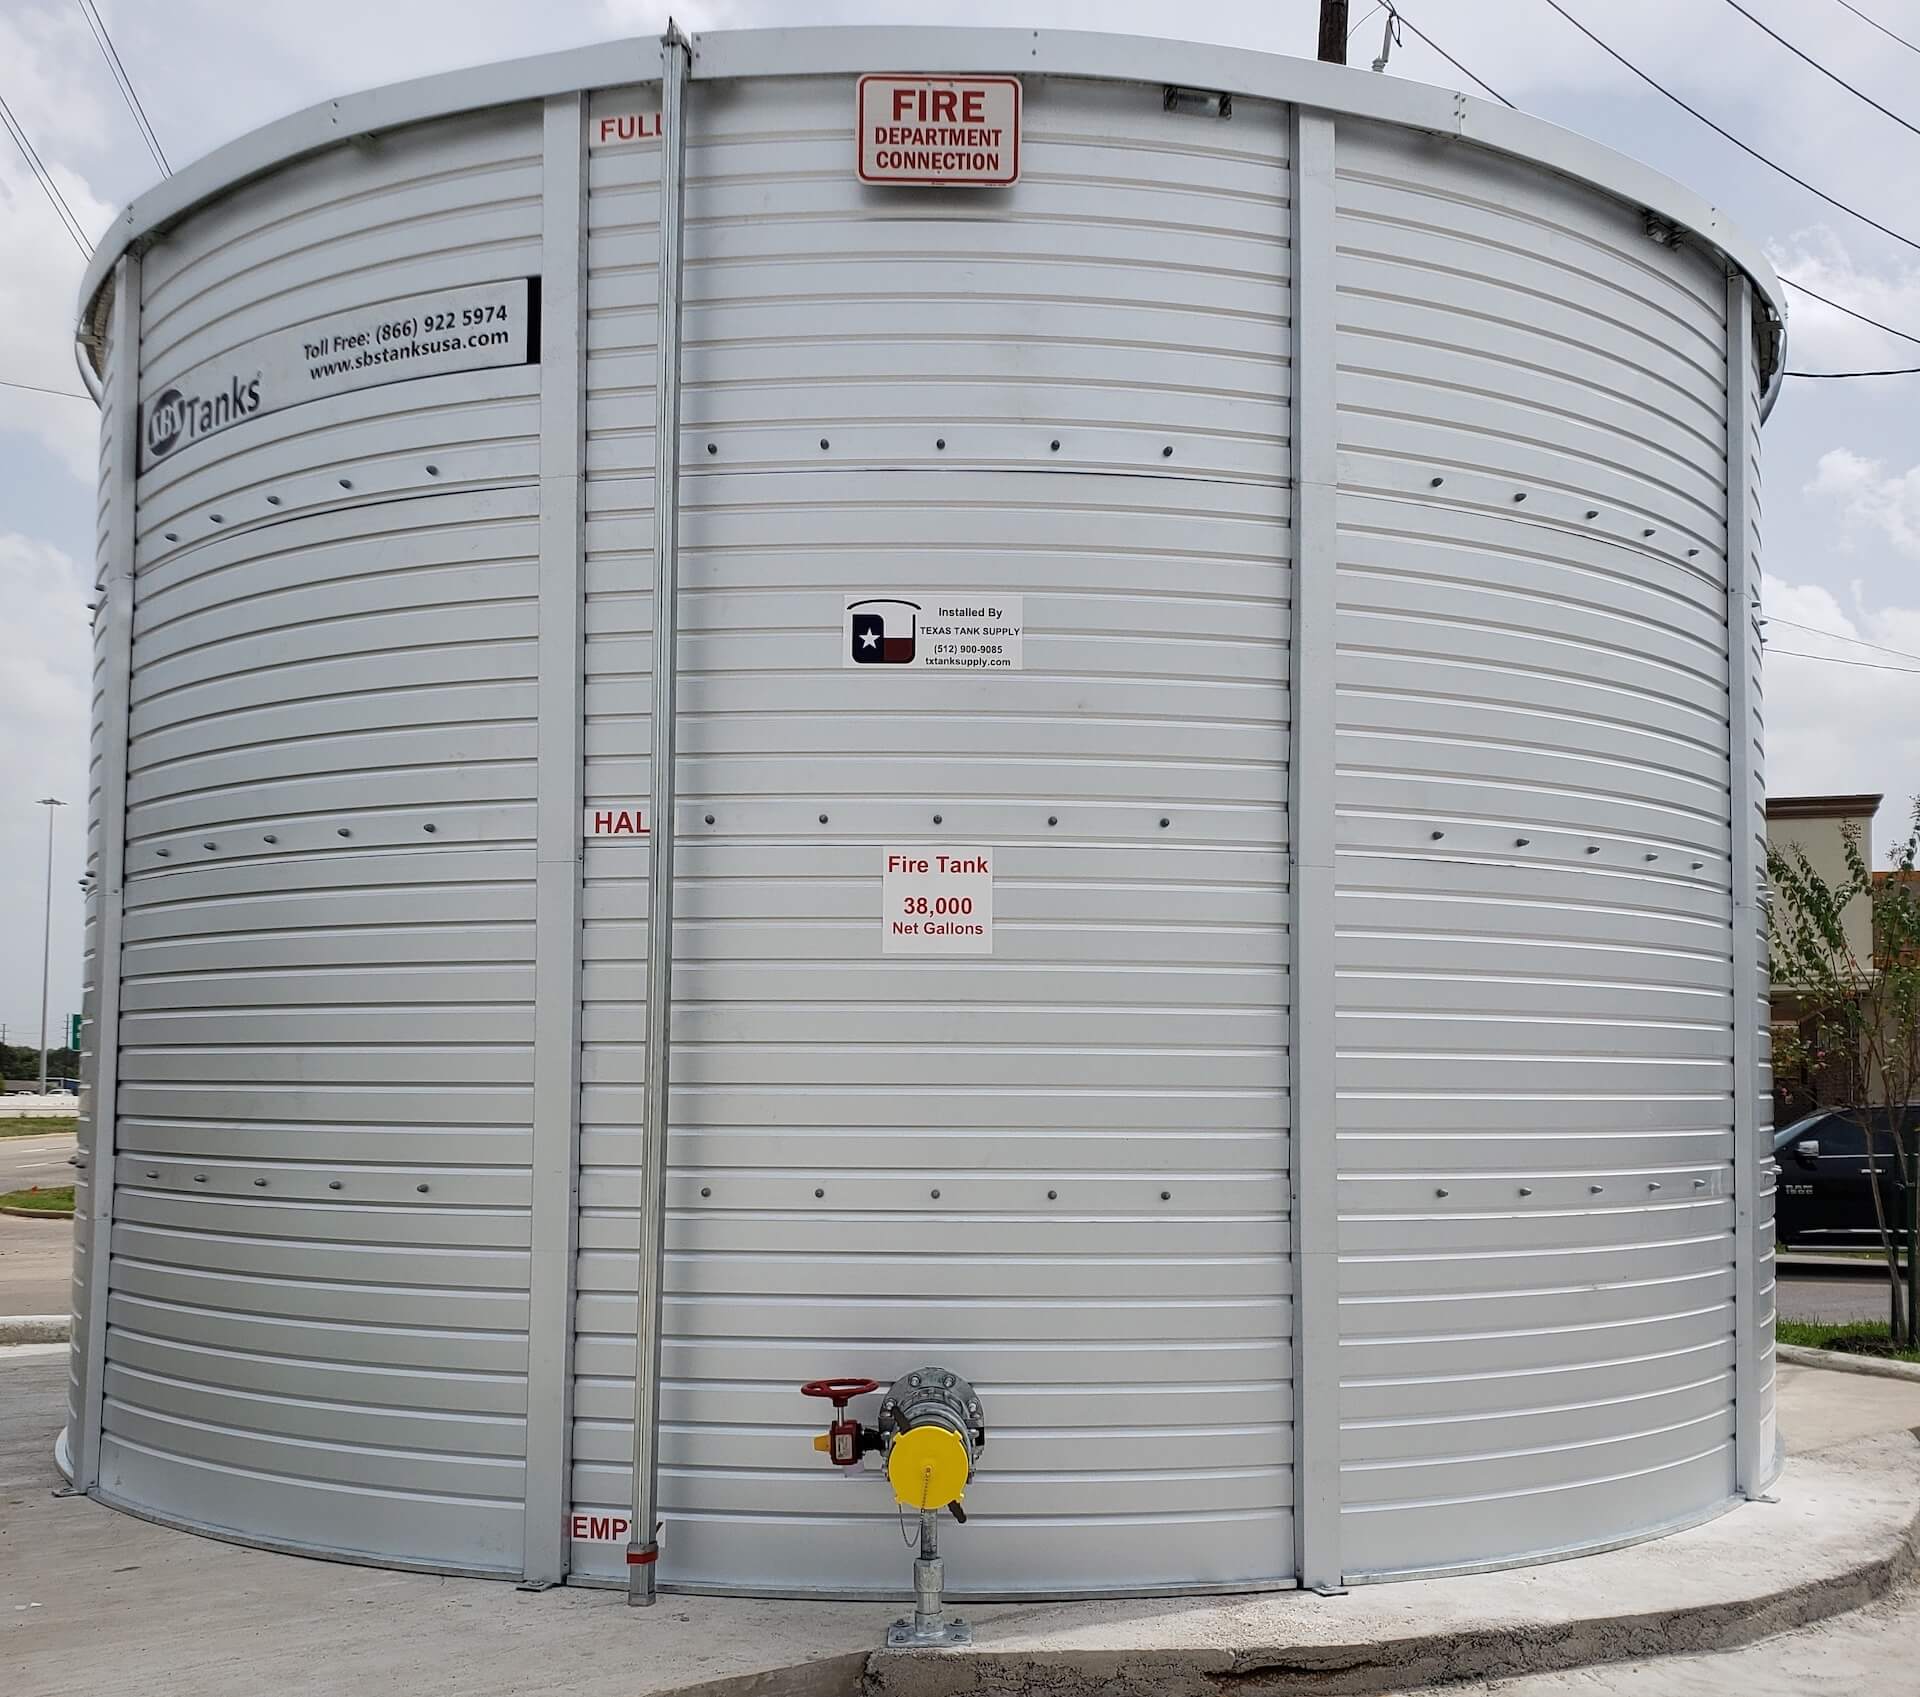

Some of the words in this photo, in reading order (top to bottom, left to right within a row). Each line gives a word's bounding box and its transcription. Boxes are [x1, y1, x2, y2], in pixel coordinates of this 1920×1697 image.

[893, 89, 985, 122] FIRE
[875, 127, 1002, 147] DEPARTMENT
[876, 151, 999, 171] CONNECTION
[304, 337, 329, 361] Toll
[333, 331, 370, 353] Free:
[376, 318, 418, 345] (866)
[424, 312, 455, 333] 922
[462, 305, 508, 326] 5974
[310, 330, 509, 379] www.sbstanksusa.com
[939, 607, 985, 617] Installed
[988, 608, 1003, 619] By
[920, 626, 952, 635] TEXAS
[954, 627, 980, 635] TANK
[983, 627, 1020, 636] SUPPLY
[934, 644, 957, 655] (512)
[960, 645, 1003, 654] 900-9085
[925, 657, 1011, 667] txtanksupply.com
[595, 811, 651, 833] HAL
[888, 856, 928, 873] Fire
[936, 856, 988, 873] Tank
[904, 897, 972, 918] 38,000
[893, 922, 918, 934] Net
[924, 922, 984, 935] Gallons
